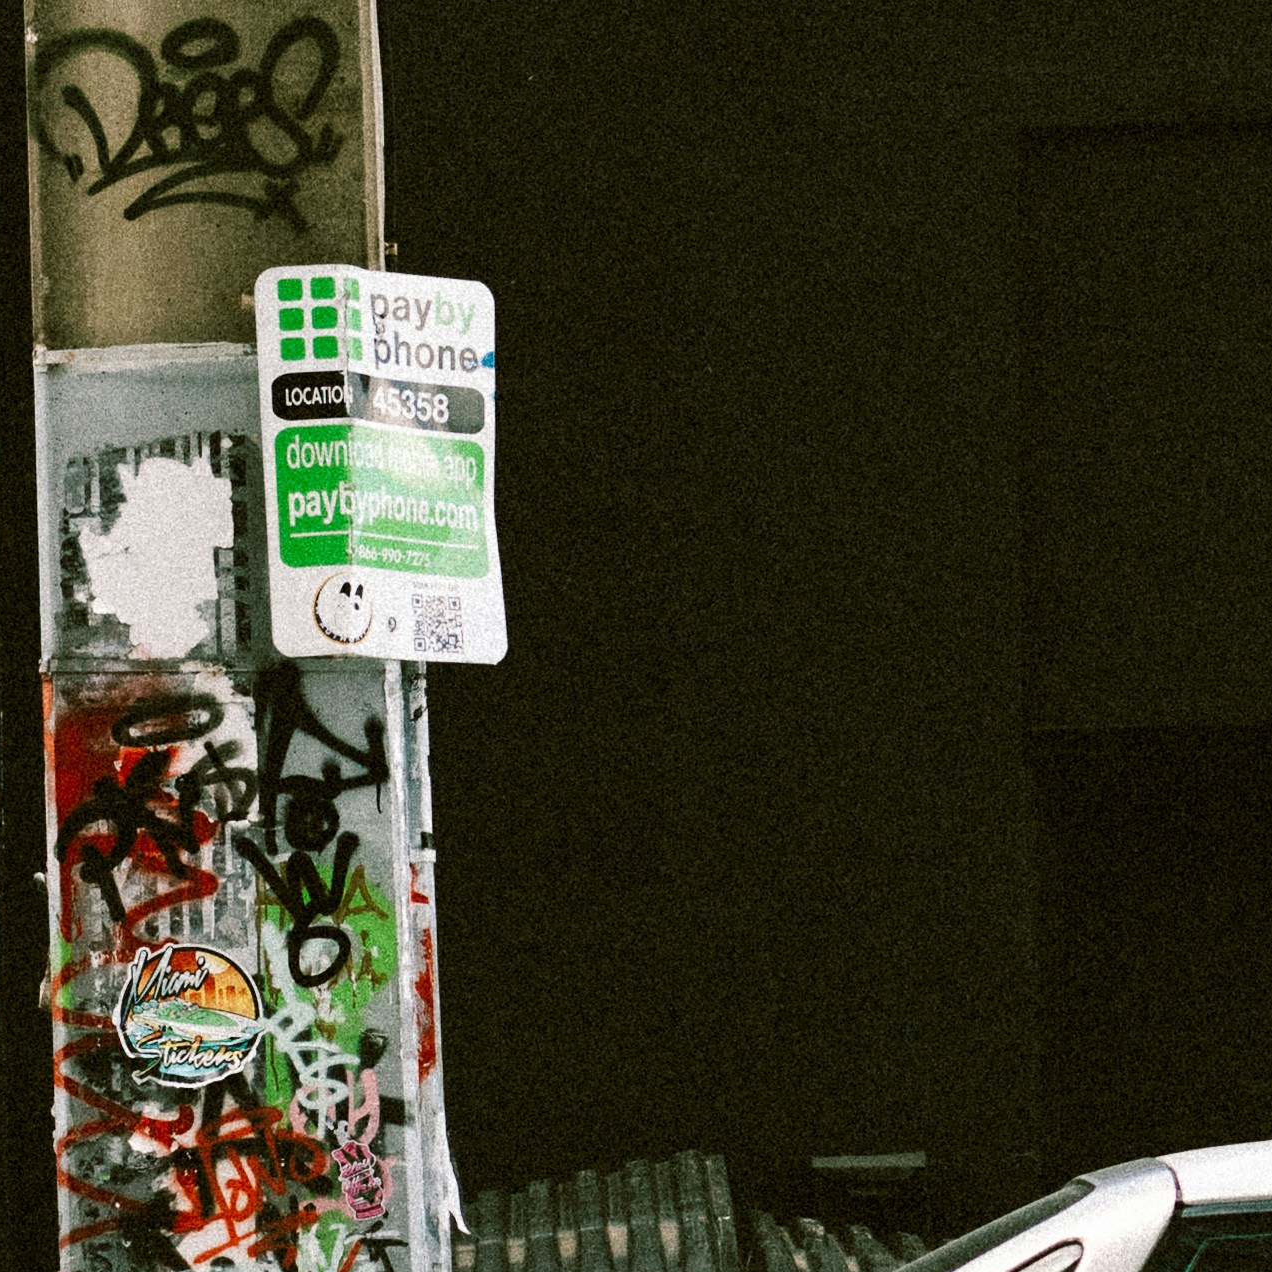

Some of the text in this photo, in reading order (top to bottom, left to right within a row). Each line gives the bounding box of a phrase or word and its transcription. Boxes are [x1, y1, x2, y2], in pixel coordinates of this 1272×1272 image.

[374, 331, 478, 373] phone
[285, 384, 450, 424] LOCATION 45358
[286, 434, 385, 470] download
[443, 455, 477, 491] app
[289, 481, 478, 529] paybyphone.com
[120, 946, 209, 1030] Miami
[131, 1031, 243, 1076] Stickers
